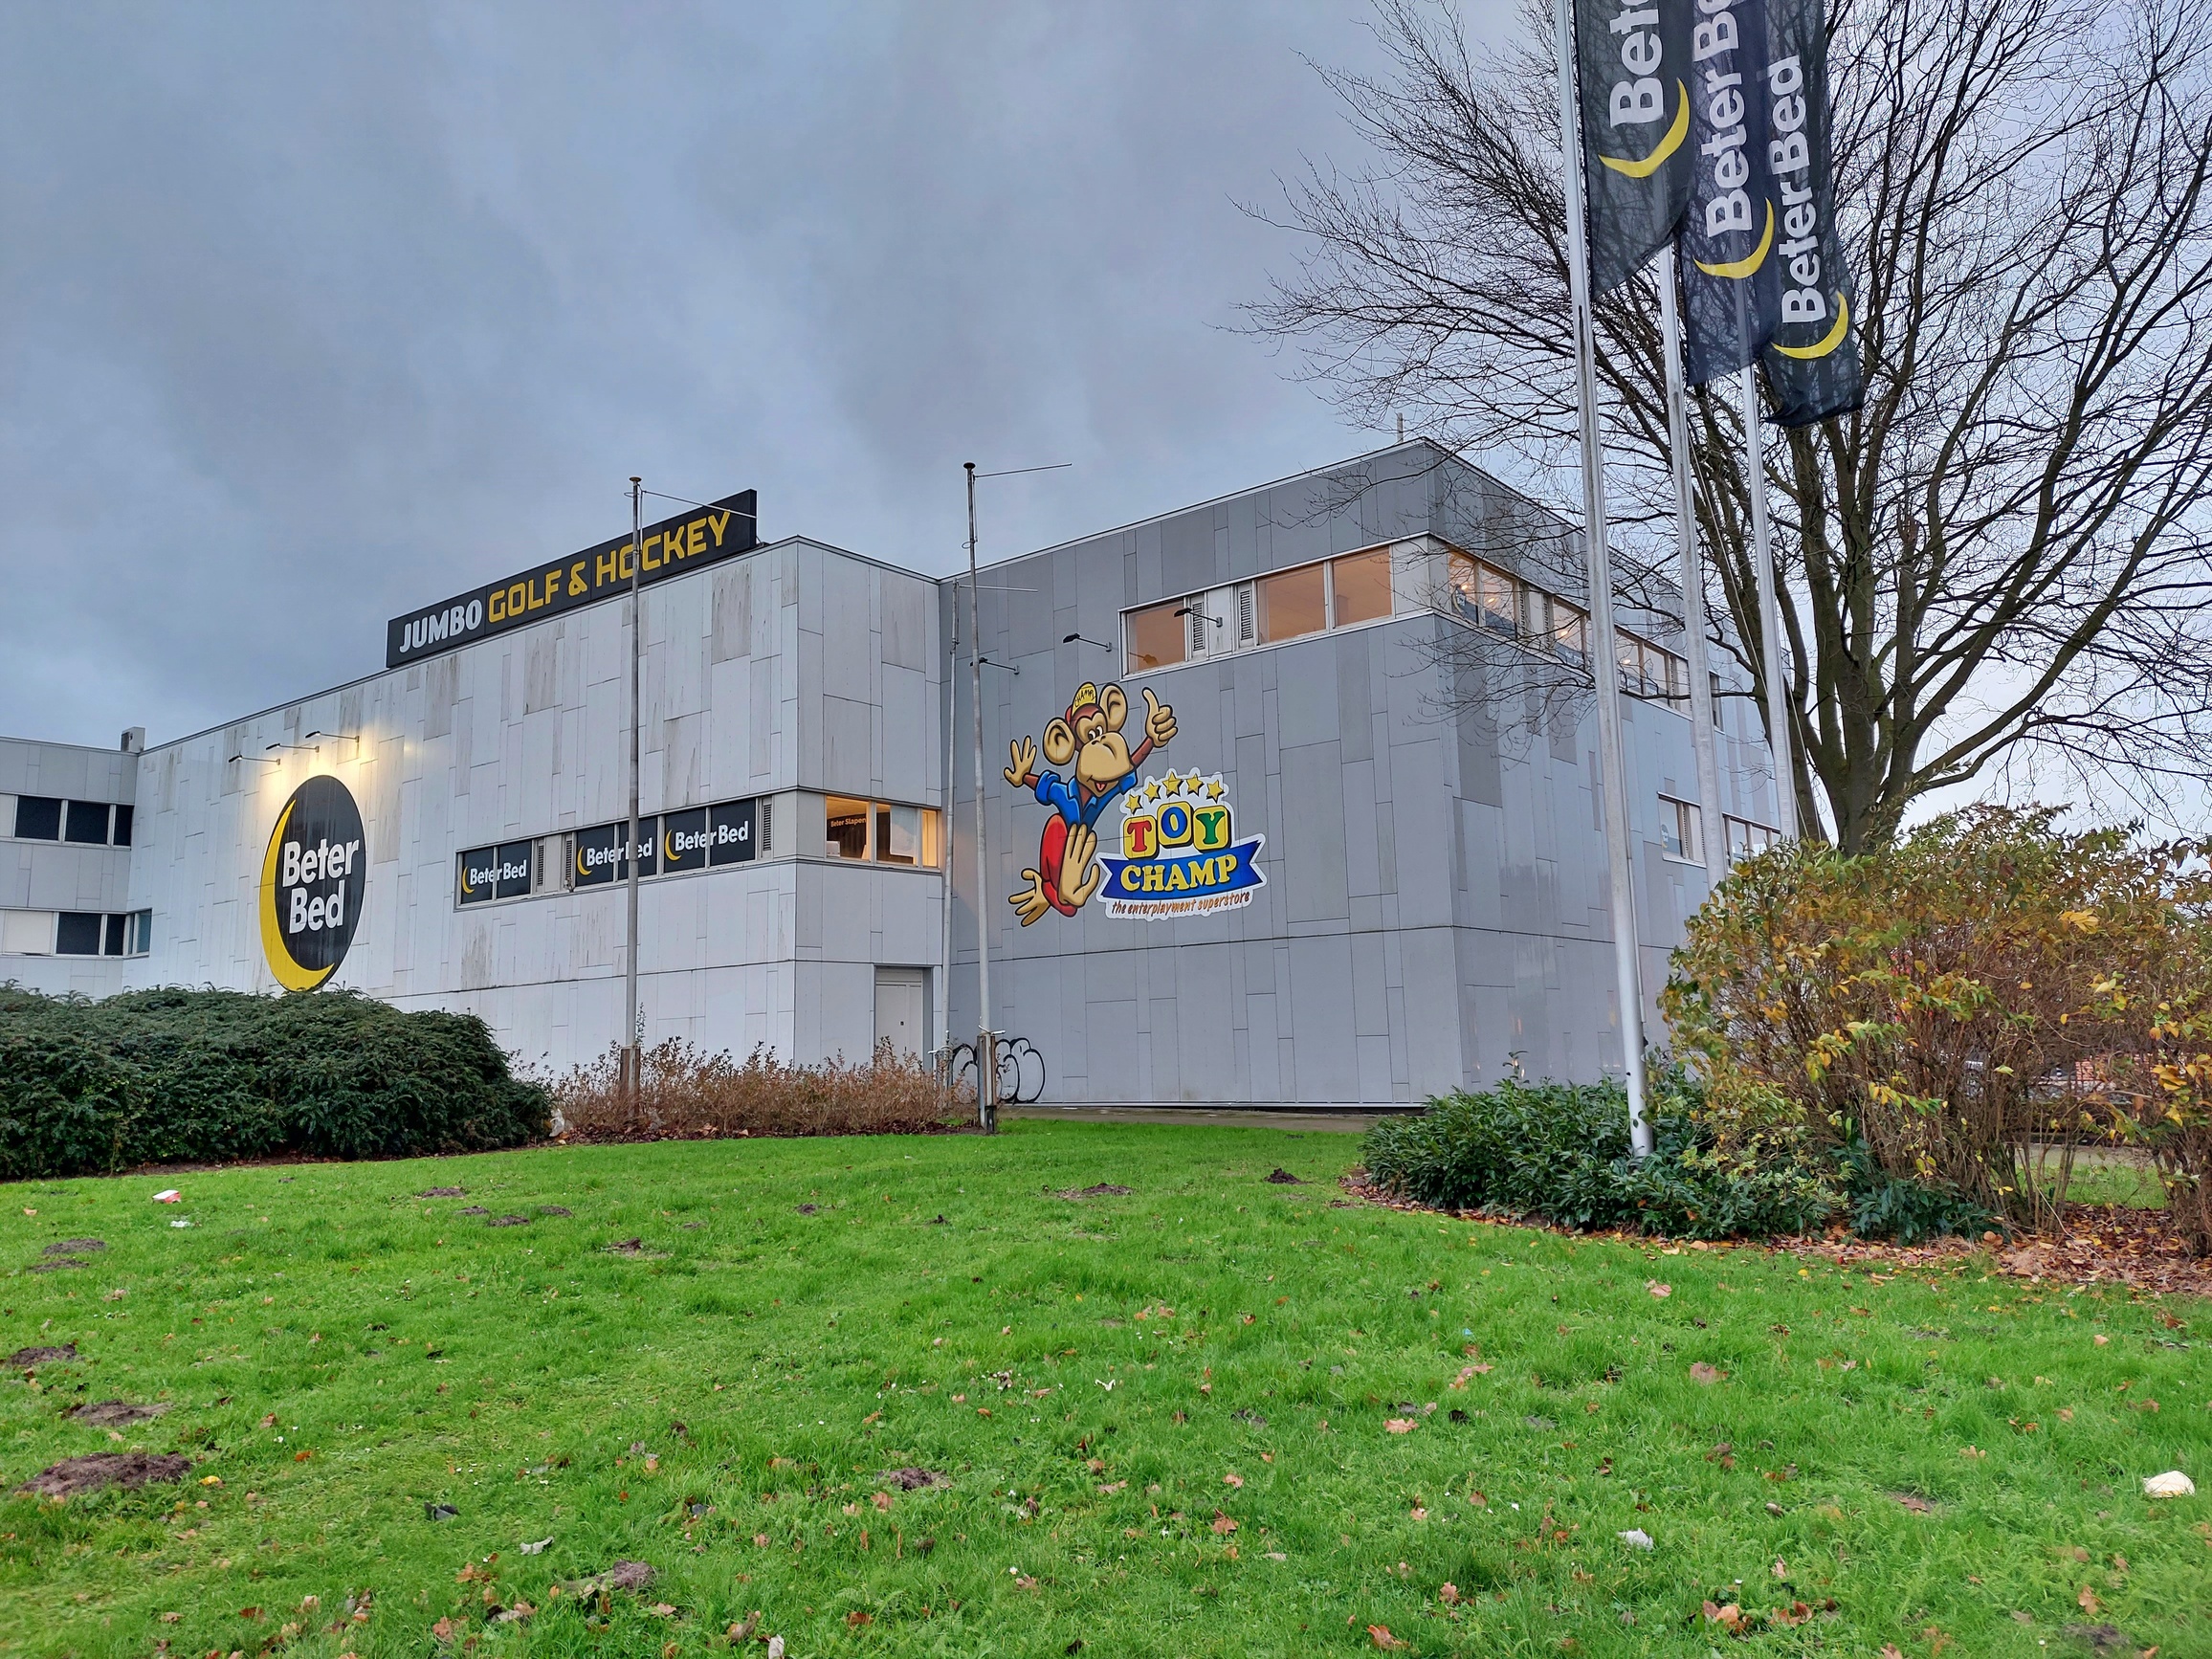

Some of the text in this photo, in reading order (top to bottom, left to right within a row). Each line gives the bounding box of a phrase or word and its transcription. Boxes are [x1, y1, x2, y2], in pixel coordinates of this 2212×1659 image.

[1609, 0, 1664, 128] Bet
[1701, 70, 1753, 238] Beter
[1757, 55, 1827, 323] Beter Bed
[399, 510, 731, 653] JUMBO GOLF & HOCKEY
[675, 821, 748, 852] Beter Bed
[1127, 806, 1226, 852] TOY
[282, 838, 360, 888] Beter
[470, 860, 526, 886] Beter Bed
[586, 846, 625, 866] Beter
[1120, 854, 1237, 892] CHAMP
[289, 879, 345, 935] Bed
[1112, 891, 1250, 917] the enterplayment superstore
